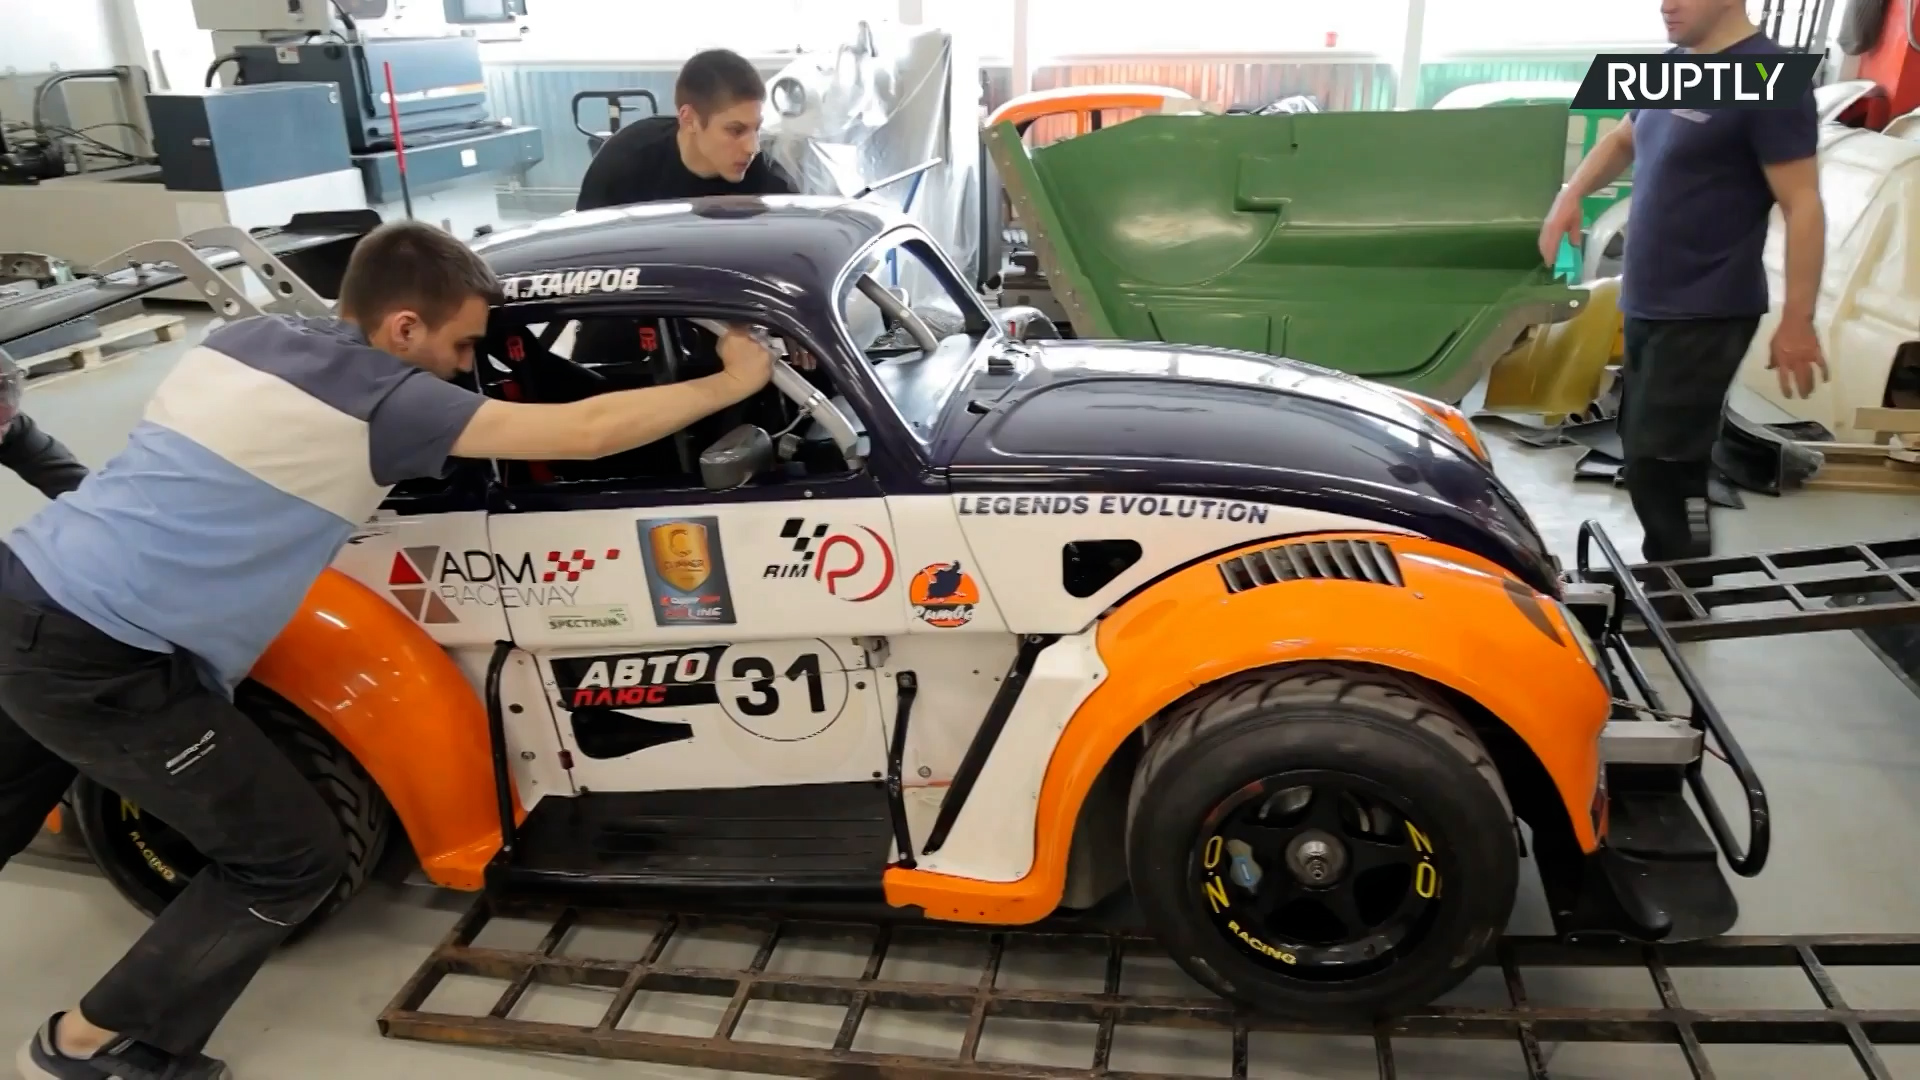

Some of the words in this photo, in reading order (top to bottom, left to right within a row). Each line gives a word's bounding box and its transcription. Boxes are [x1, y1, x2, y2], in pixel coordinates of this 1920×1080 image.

[958, 496, 1090, 516] LEGENDS
[440, 551, 537, 584] ADM
[762, 564, 810, 578] RIM
[439, 584, 580, 608] RACEWAY
[577, 651, 710, 690] АВТО
[731, 652, 826, 717] 31
[573, 684, 668, 707] ПЛЮС
[1227, 919, 1297, 966] RACING
